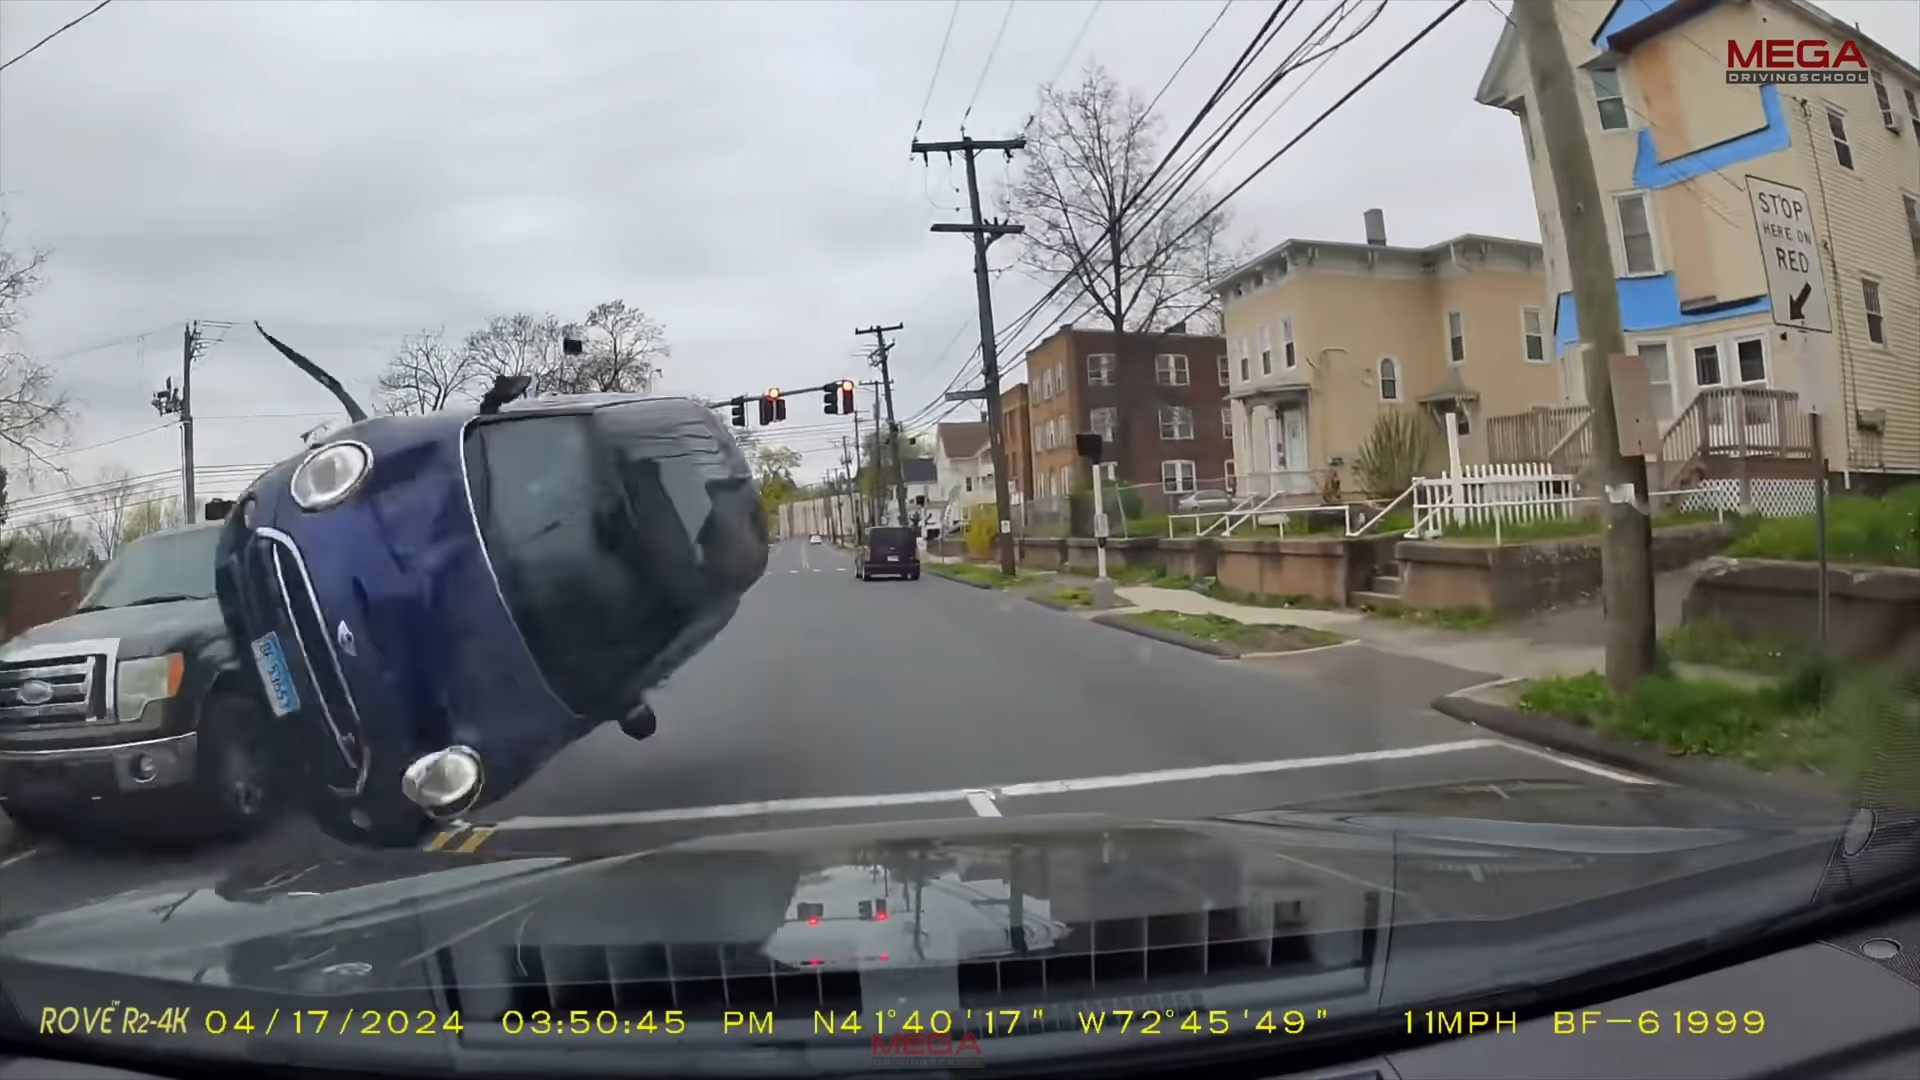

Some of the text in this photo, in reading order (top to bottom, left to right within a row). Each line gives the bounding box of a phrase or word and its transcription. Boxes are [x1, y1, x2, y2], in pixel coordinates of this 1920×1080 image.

[1759, 191, 1803, 221] STOP
[1763, 223, 1812, 246] HERE ON
[1775, 246, 1809, 274] RED
